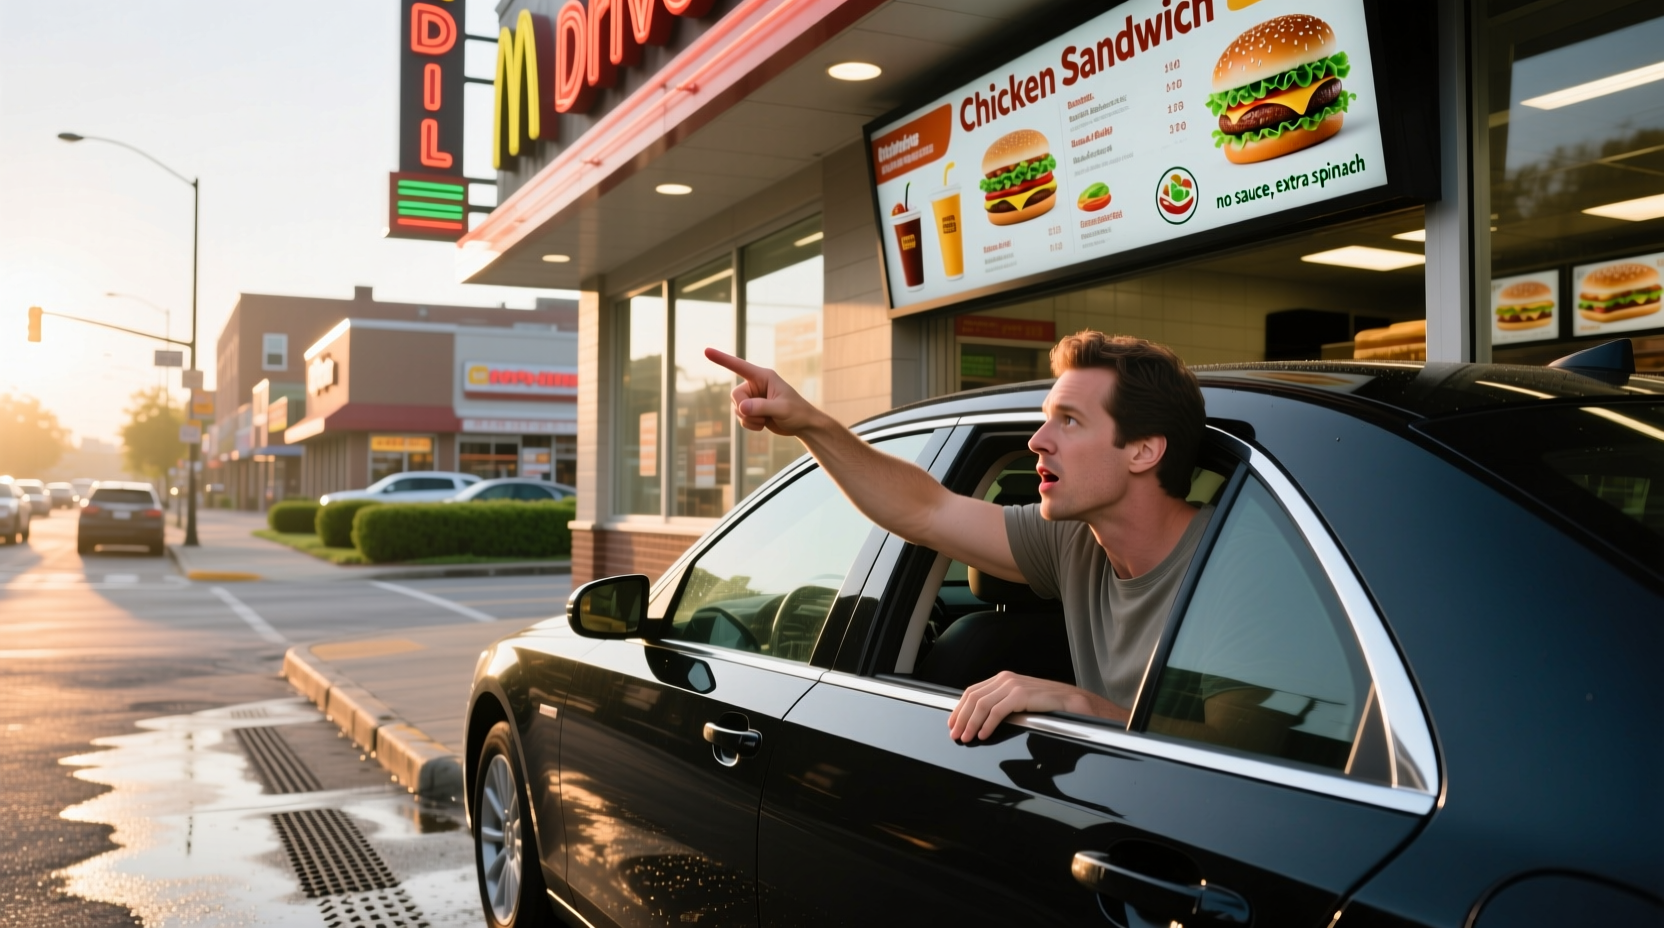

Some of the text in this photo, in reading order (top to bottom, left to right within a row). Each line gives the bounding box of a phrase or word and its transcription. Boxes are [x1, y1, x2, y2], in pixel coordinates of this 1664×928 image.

[555, 0, 693, 113] Driv
[960, 0, 1214, 132] Chicken Sandwich
[1216, 153, 1365, 208] no sauce, extra spinach
